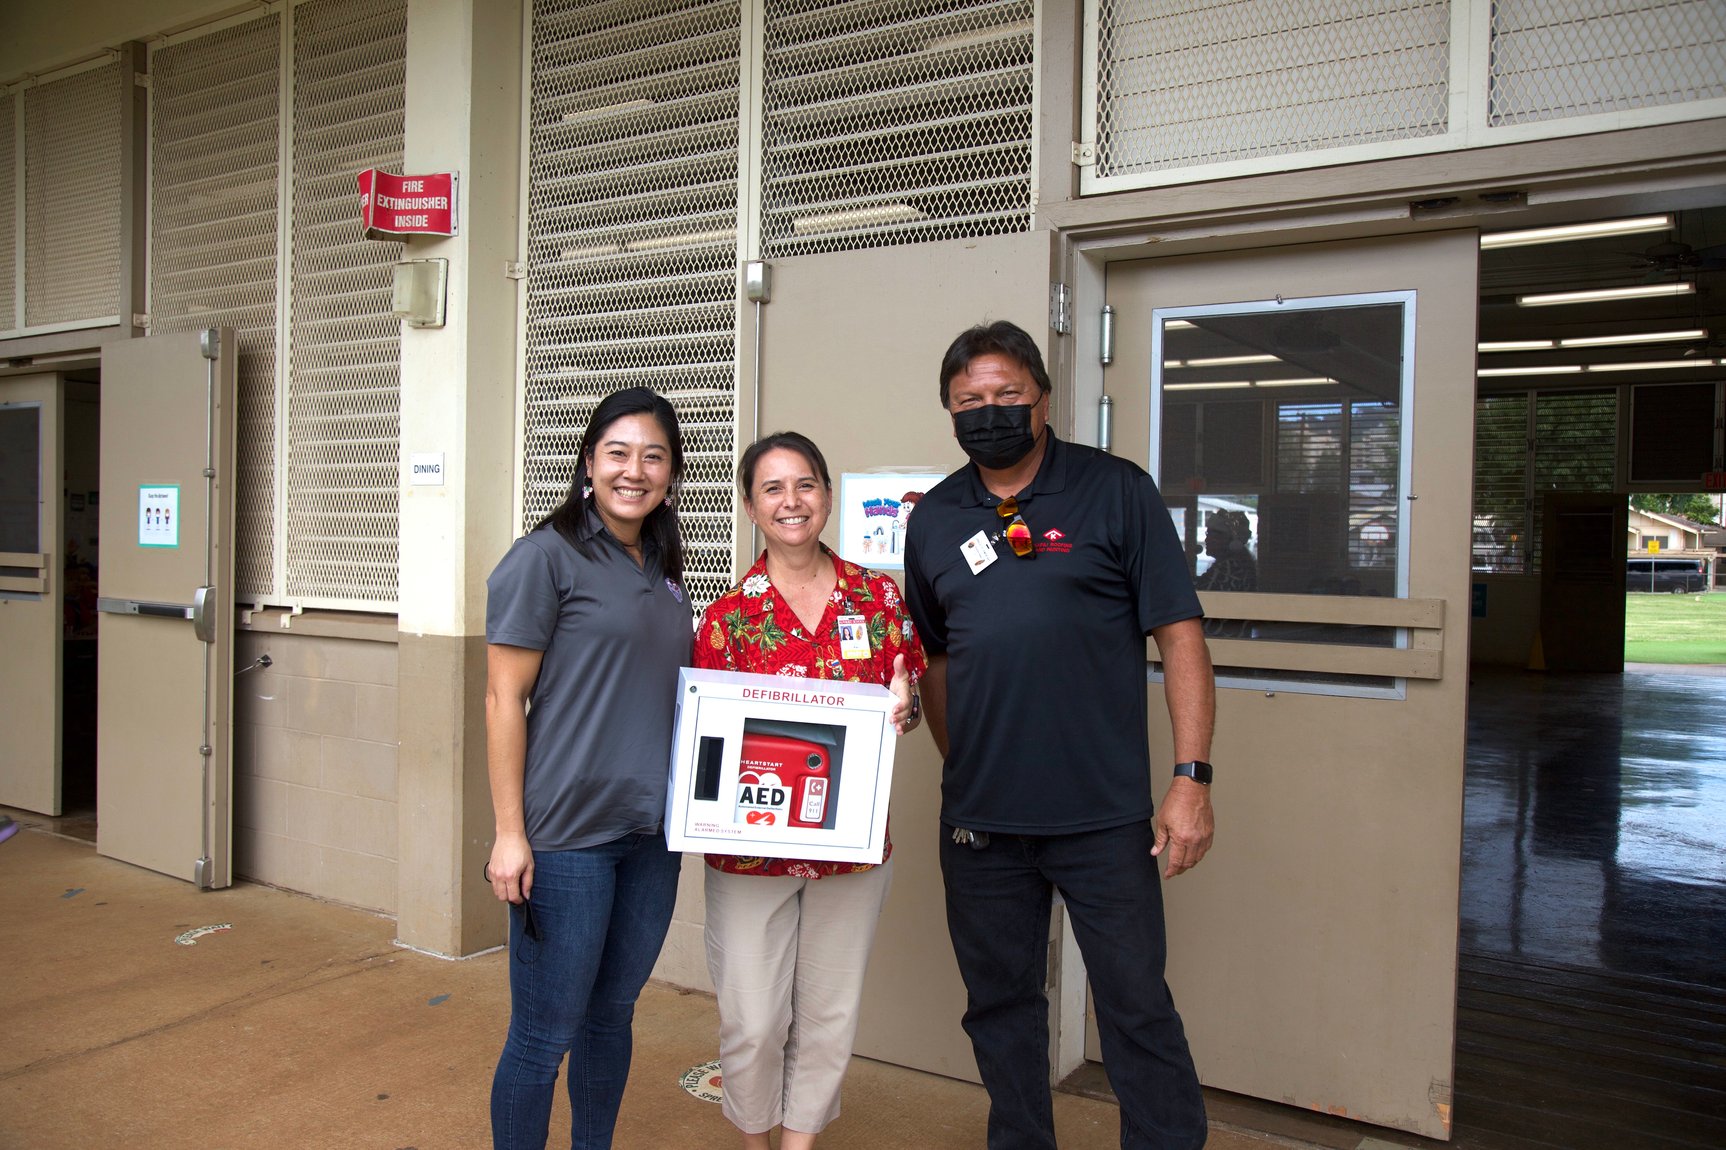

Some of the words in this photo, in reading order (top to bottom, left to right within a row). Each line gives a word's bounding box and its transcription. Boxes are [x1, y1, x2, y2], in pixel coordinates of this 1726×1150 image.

[402, 180, 424, 193] FIRE
[377, 193, 448, 210] EXTINGUISHER
[394, 215, 429, 227] INSIDE
[413, 464, 441, 474] DINING
[742, 688, 845, 706] DEFIBRILLATOR
[739, 786, 786, 806] AED
[685, 1069, 709, 1089] PLEASE
